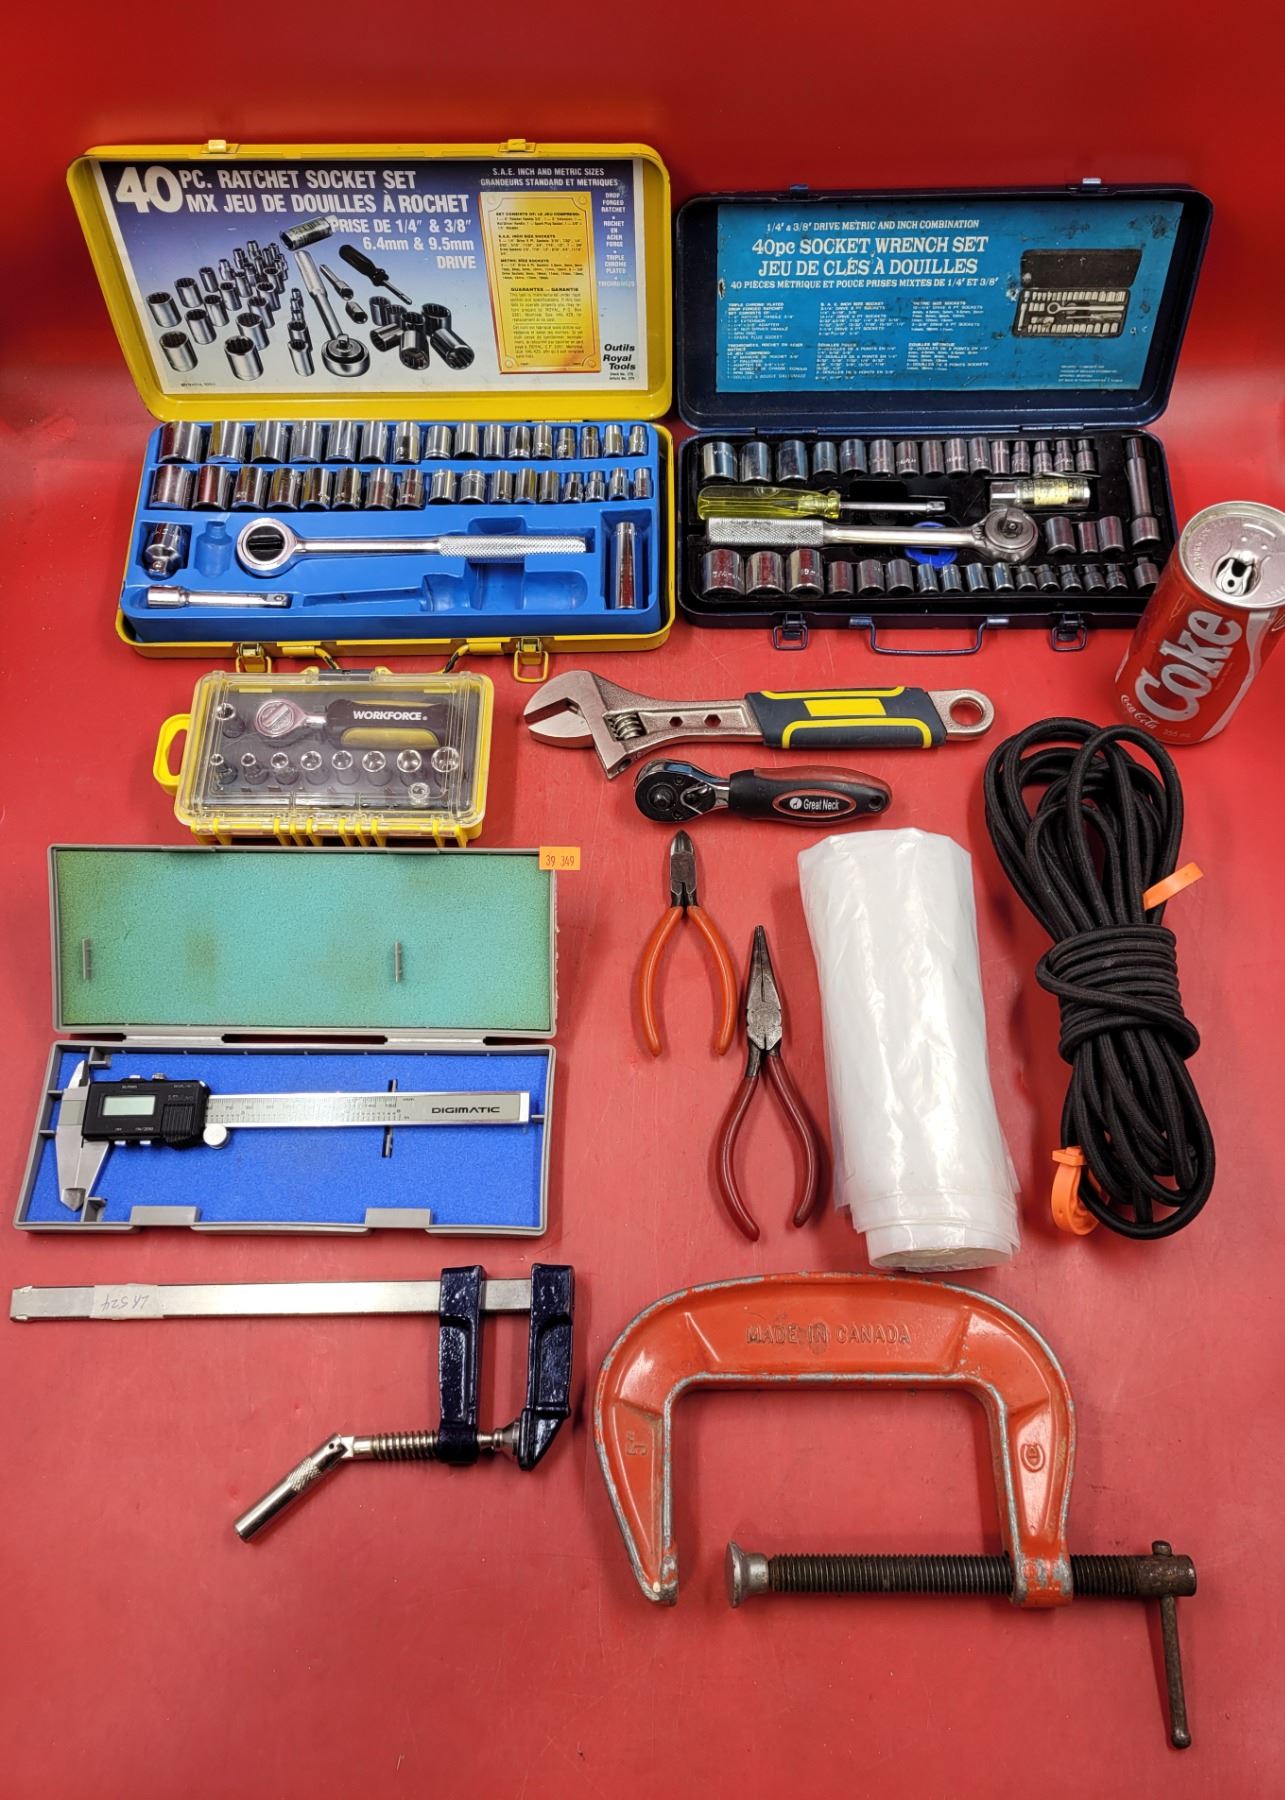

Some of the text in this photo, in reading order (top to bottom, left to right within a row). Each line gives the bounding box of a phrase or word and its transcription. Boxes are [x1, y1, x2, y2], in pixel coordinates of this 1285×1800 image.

[493, 168, 604, 176] S.A.E. INCH AND METRIC SIZES
[480, 178, 523, 186] GRANDEURS
[525, 178, 563, 186] STANDARD
[566, 178, 574, 186] ET
[115, 165, 416, 213] 40 PC. RATCHET SOCKET SET
[185, 190, 469, 213] MX JEU DE DOUILLES À ROCHET
[330, 218, 370, 233] PRISE
[374, 218, 391, 233] DE
[429, 218, 440, 233] &
[814, 222, 841, 231] DRIVE
[842, 221, 876, 230] METRIC
[878, 221, 895, 230] AND
[897, 221, 917, 229] INCH
[919, 220, 979, 229] COMBINATION
[363, 237, 474, 250] 6.4mm & 9.5mm
[752, 236, 989, 257] 40pc SOCKET WRENCH SET
[436, 255, 477, 269] DRIVE
[758, 257, 978, 277] JEU DE CLÉS À DOUILLES
[730, 280, 742, 289] 40
[823, 280, 835, 288] ET
[836, 280, 864, 288] POUCE
[866, 279, 897, 288] PRISES
[900, 279, 931, 287] MIXTES
[933, 278, 946, 287] DE
[967, 278, 978, 286] ET
[604, 343, 635, 351] Outils
[603, 354, 632, 363] Royal
[1135, 610, 1242, 722] Coke
[353, 709, 423, 721] WORKFORCE
[803, 799, 839, 810] Great Neck
[545, 854, 556, 867] 39
[431, 1106, 500, 1114] DIGIMATIC
[746, 1322, 912, 1344] MADE IN CANADA
